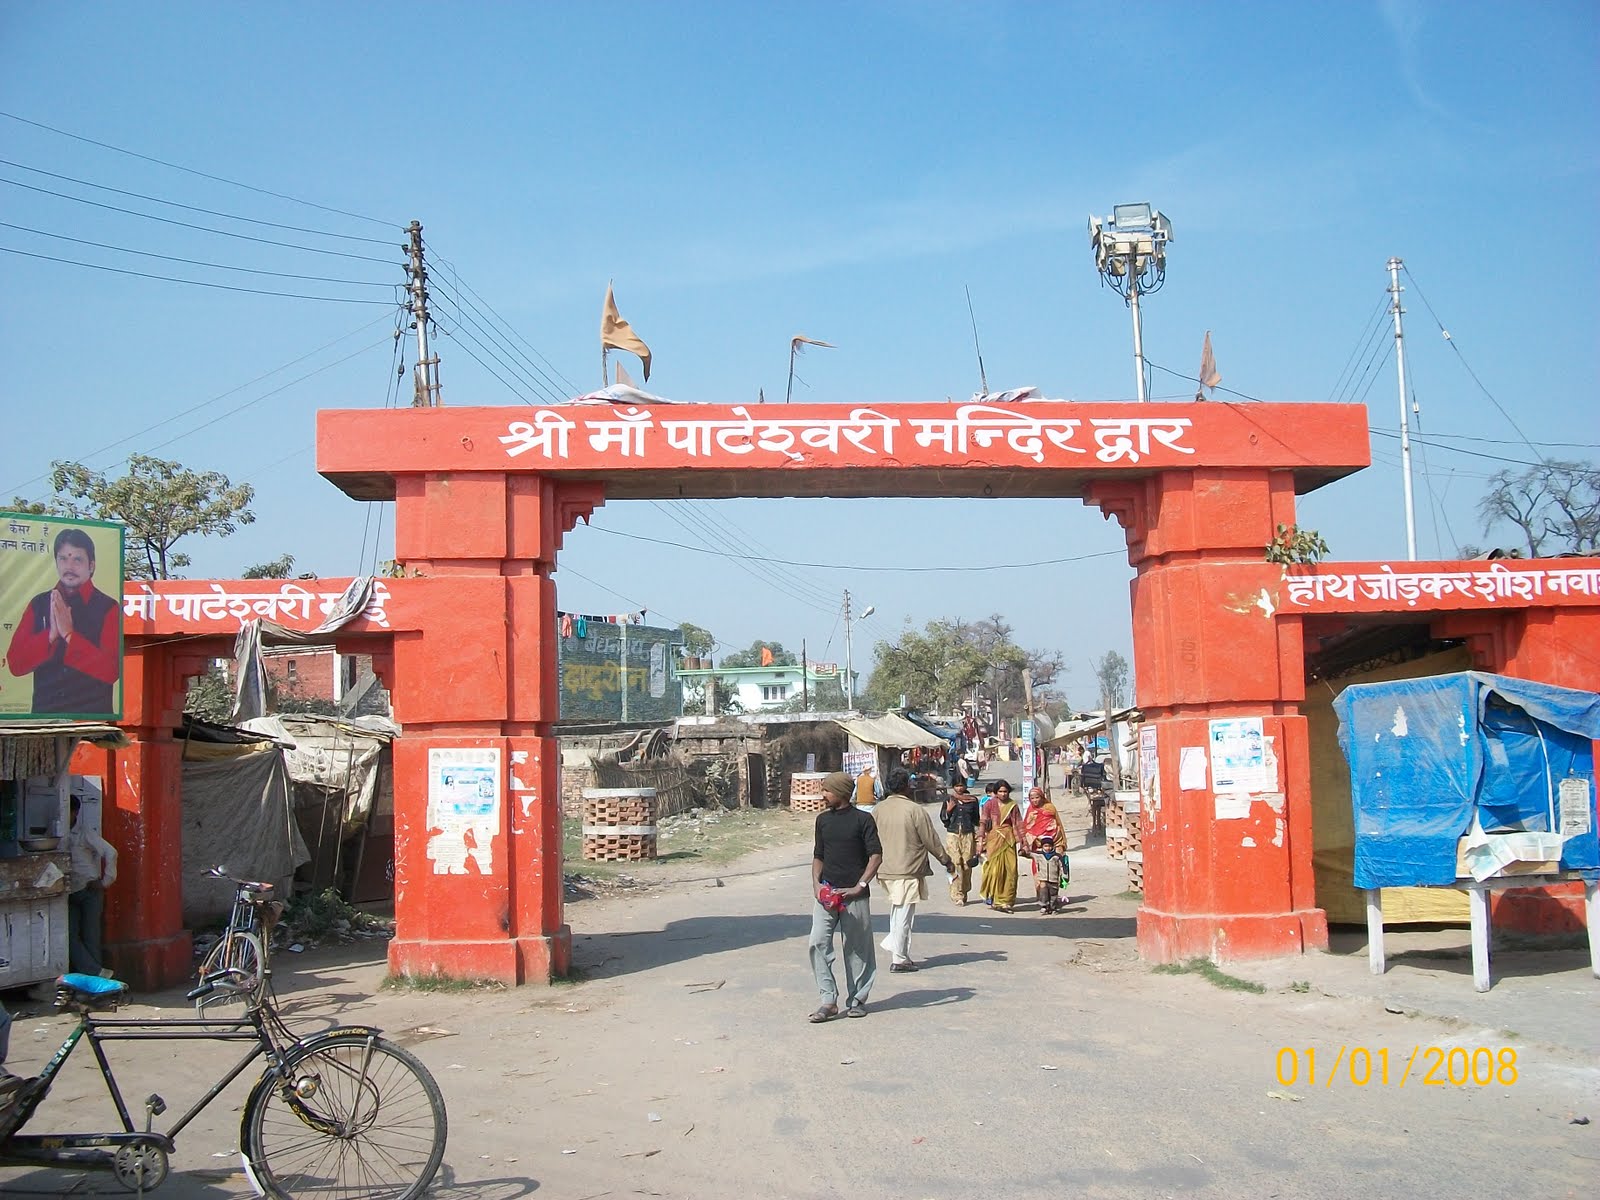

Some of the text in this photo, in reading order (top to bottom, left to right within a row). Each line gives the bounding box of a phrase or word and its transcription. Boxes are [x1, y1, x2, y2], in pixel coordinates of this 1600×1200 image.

[498, 405, 1196, 463] श्री माँ पाटेश्वरी मन्दिर द्वार
[163, 584, 316, 626] पाटेश्वरी
[1286, 573, 1356, 606] हाथ
[1473, 563, 1546, 601] शीश
